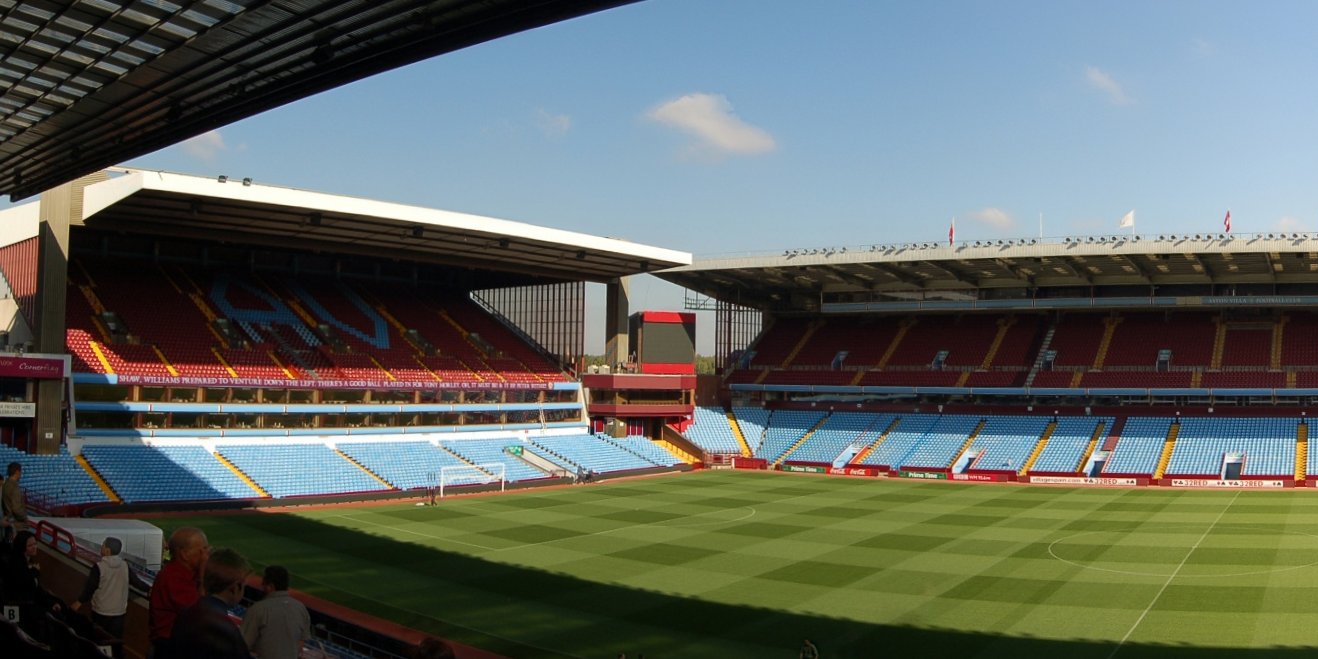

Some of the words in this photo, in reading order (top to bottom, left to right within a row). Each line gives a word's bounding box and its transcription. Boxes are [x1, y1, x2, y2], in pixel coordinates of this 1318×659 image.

[119, 375, 142, 384] SHAW,
[144, 375, 181, 384] WILLIAMS
[182, 376, 218, 385] PREPARED
[218, 377, 229, 385] TO
[229, 378, 263, 386] VENTURE
[264, 379, 284, 387] DOWN
[285, 379, 299, 387] THE
[350, 380, 367, 388] GOOD
[8, 609, 15, 620] B
